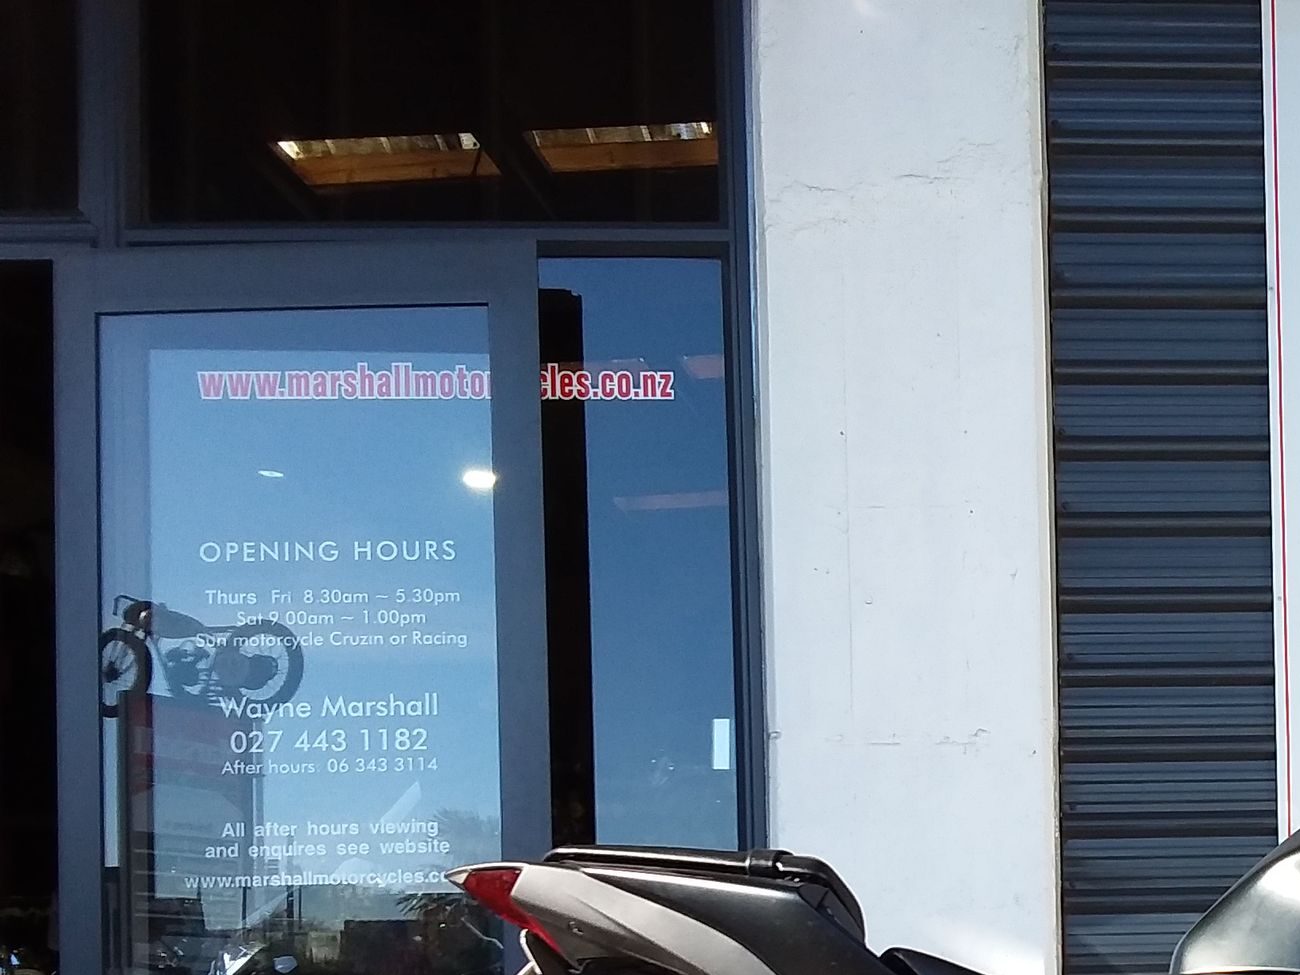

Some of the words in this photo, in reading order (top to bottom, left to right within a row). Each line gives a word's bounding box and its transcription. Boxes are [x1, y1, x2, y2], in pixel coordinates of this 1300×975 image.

[199, 541, 339, 563] OPENING
[353, 540, 457, 562] HOURS
[205, 589, 257, 605] Thurs
[271, 589, 291, 604] Fri
[236, 610, 263, 626] Sat
[362, 609, 426, 627] 1.00pm
[195, 633, 227, 648] Sun
[233, 631, 323, 650] motorcycle
[329, 631, 384, 646] Cruzin
[390, 634, 407, 646] or
[412, 631, 468, 648] Racing
[218, 695, 312, 724] Wayne
[321, 692, 439, 718] Marshall
[230, 730, 283, 753] 027
[294, 729, 347, 752] 443
[360, 728, 428, 751] 1182
[221, 759, 262, 775] After
[327, 758, 349, 773] 06
[355, 758, 388, 772] 343
[394, 757, 439, 772] 3114
[221, 822, 245, 838] All
[253, 821, 297, 838] after
[307, 820, 359, 837] hours
[369, 818, 439, 837] viewing
[204, 843, 239, 858] and
[248, 841, 327, 861] enquires
[336, 842, 370, 855] see
[379, 838, 450, 855] website
